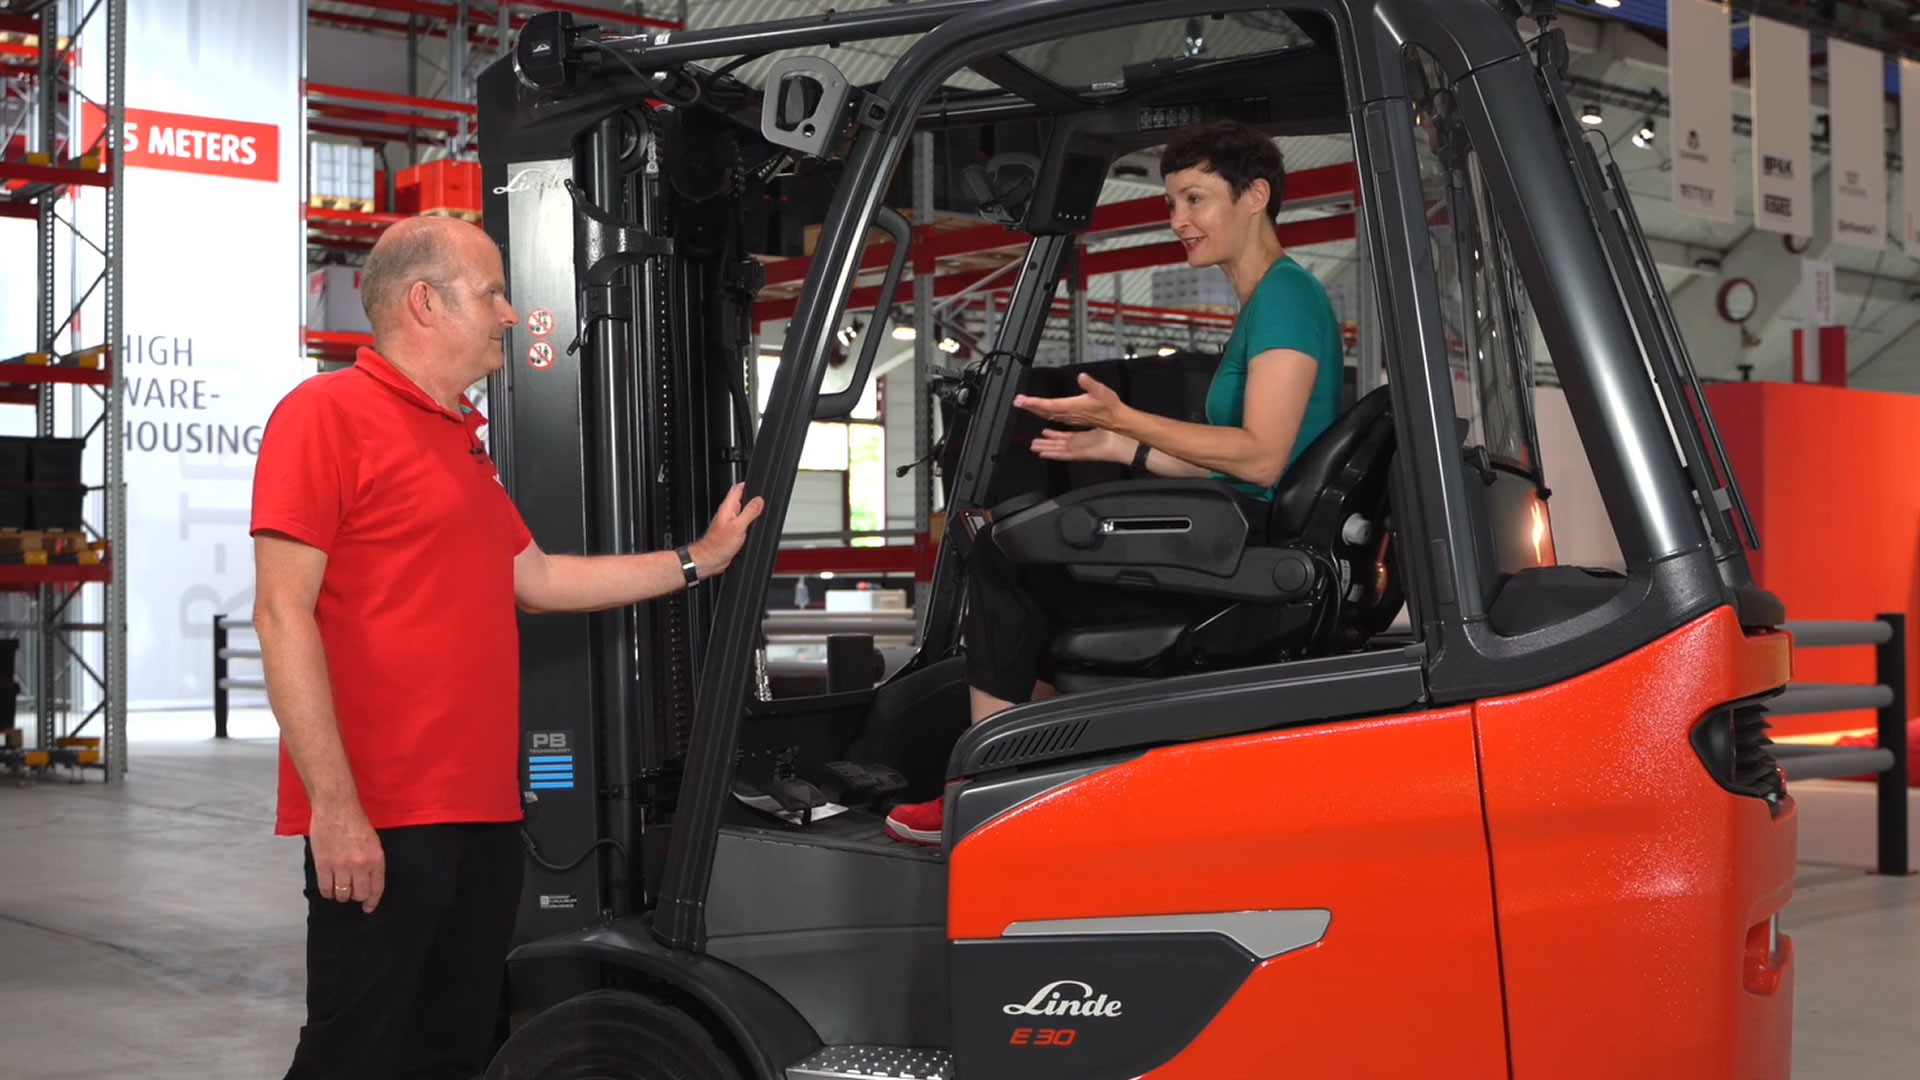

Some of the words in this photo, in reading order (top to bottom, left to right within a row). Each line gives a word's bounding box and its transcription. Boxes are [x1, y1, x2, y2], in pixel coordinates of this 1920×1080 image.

[148, 125, 257, 165] METERS
[123, 334, 192, 367] HIGH
[123, 376, 220, 410] WARE-
[122, 420, 262, 456] HOUSING
[533, 733, 566, 748] PB
[1002, 979, 1122, 1017] Linde
[1009, 1028, 1033, 1045] E
[1033, 1028, 1077, 1047] 30
